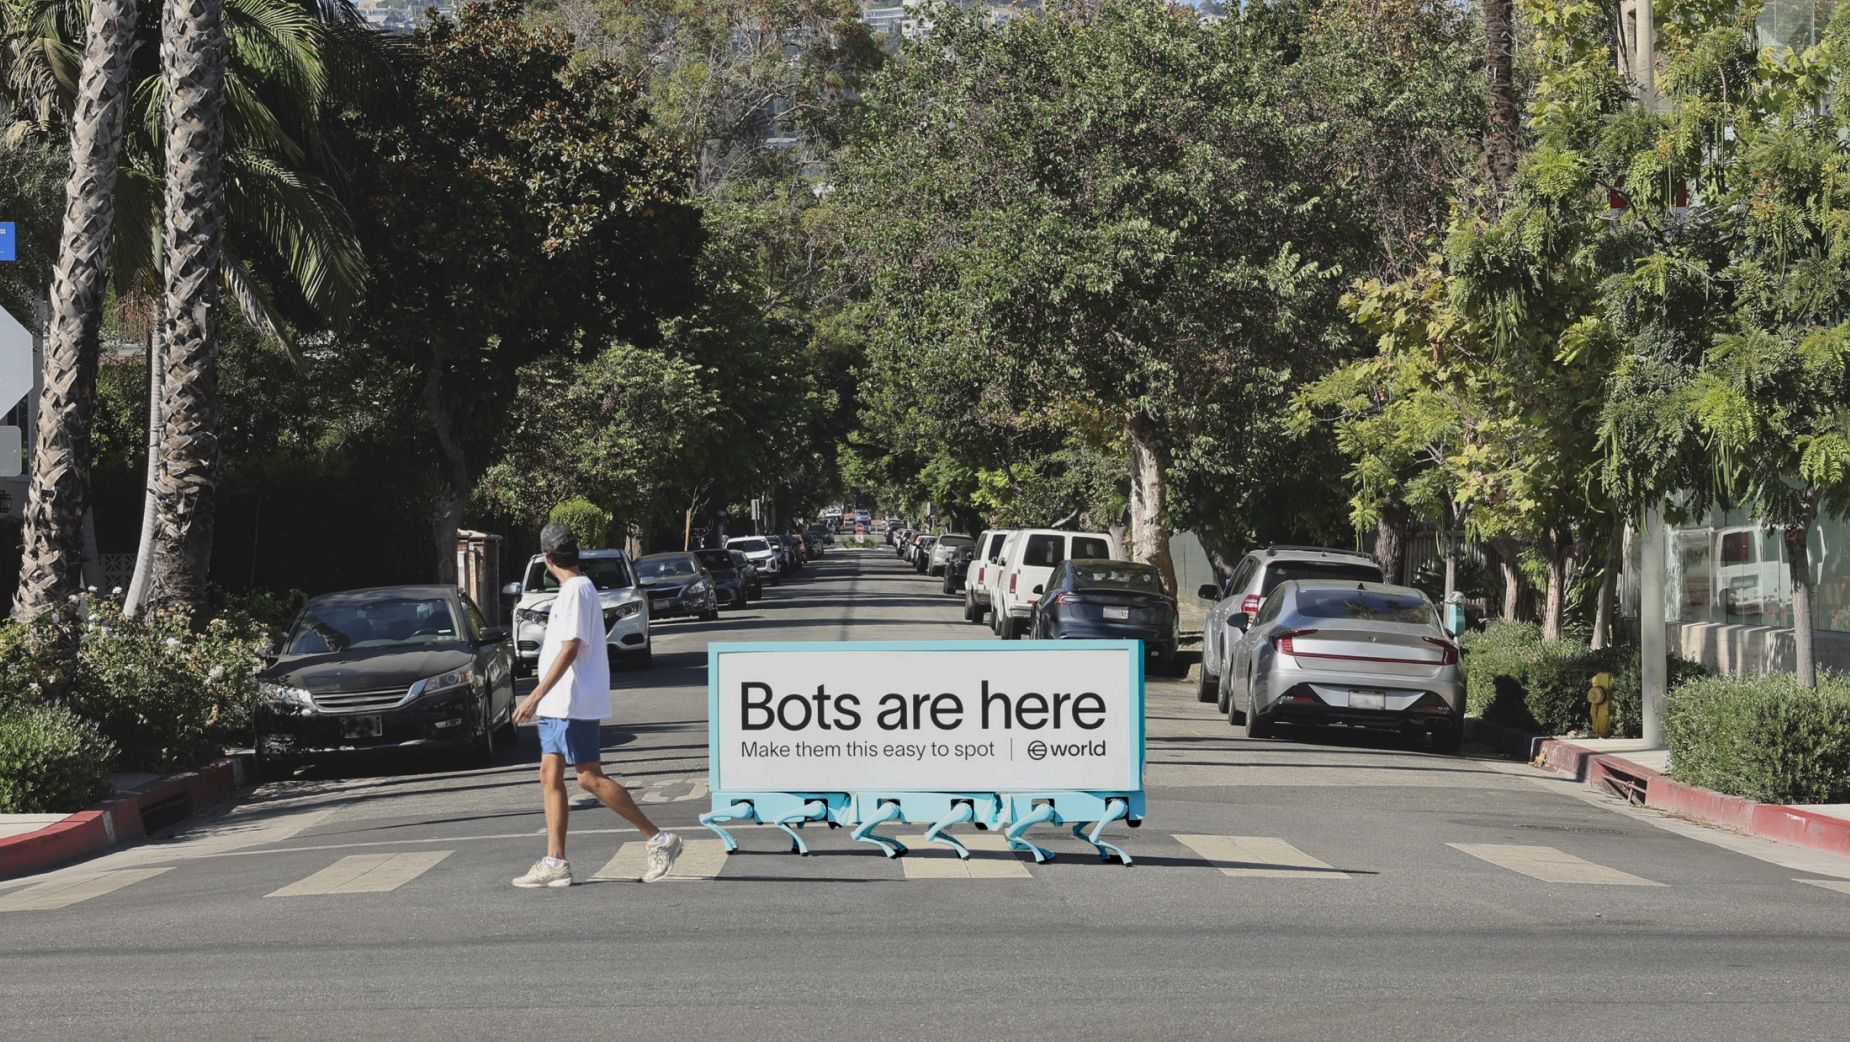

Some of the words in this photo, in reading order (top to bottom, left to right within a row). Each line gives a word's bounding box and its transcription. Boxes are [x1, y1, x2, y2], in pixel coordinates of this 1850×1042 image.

[740, 681, 862, 732] Bots
[876, 692, 964, 731] are
[980, 679, 1107, 730] here
[740, 741, 791, 758] Make
[795, 741, 841, 757] them
[845, 741, 879, 757] this
[883, 745, 927, 761] easy
[931, 742, 950, 757] to
[954, 742, 995, 761] spot
[1050, 740, 1106, 757] world
